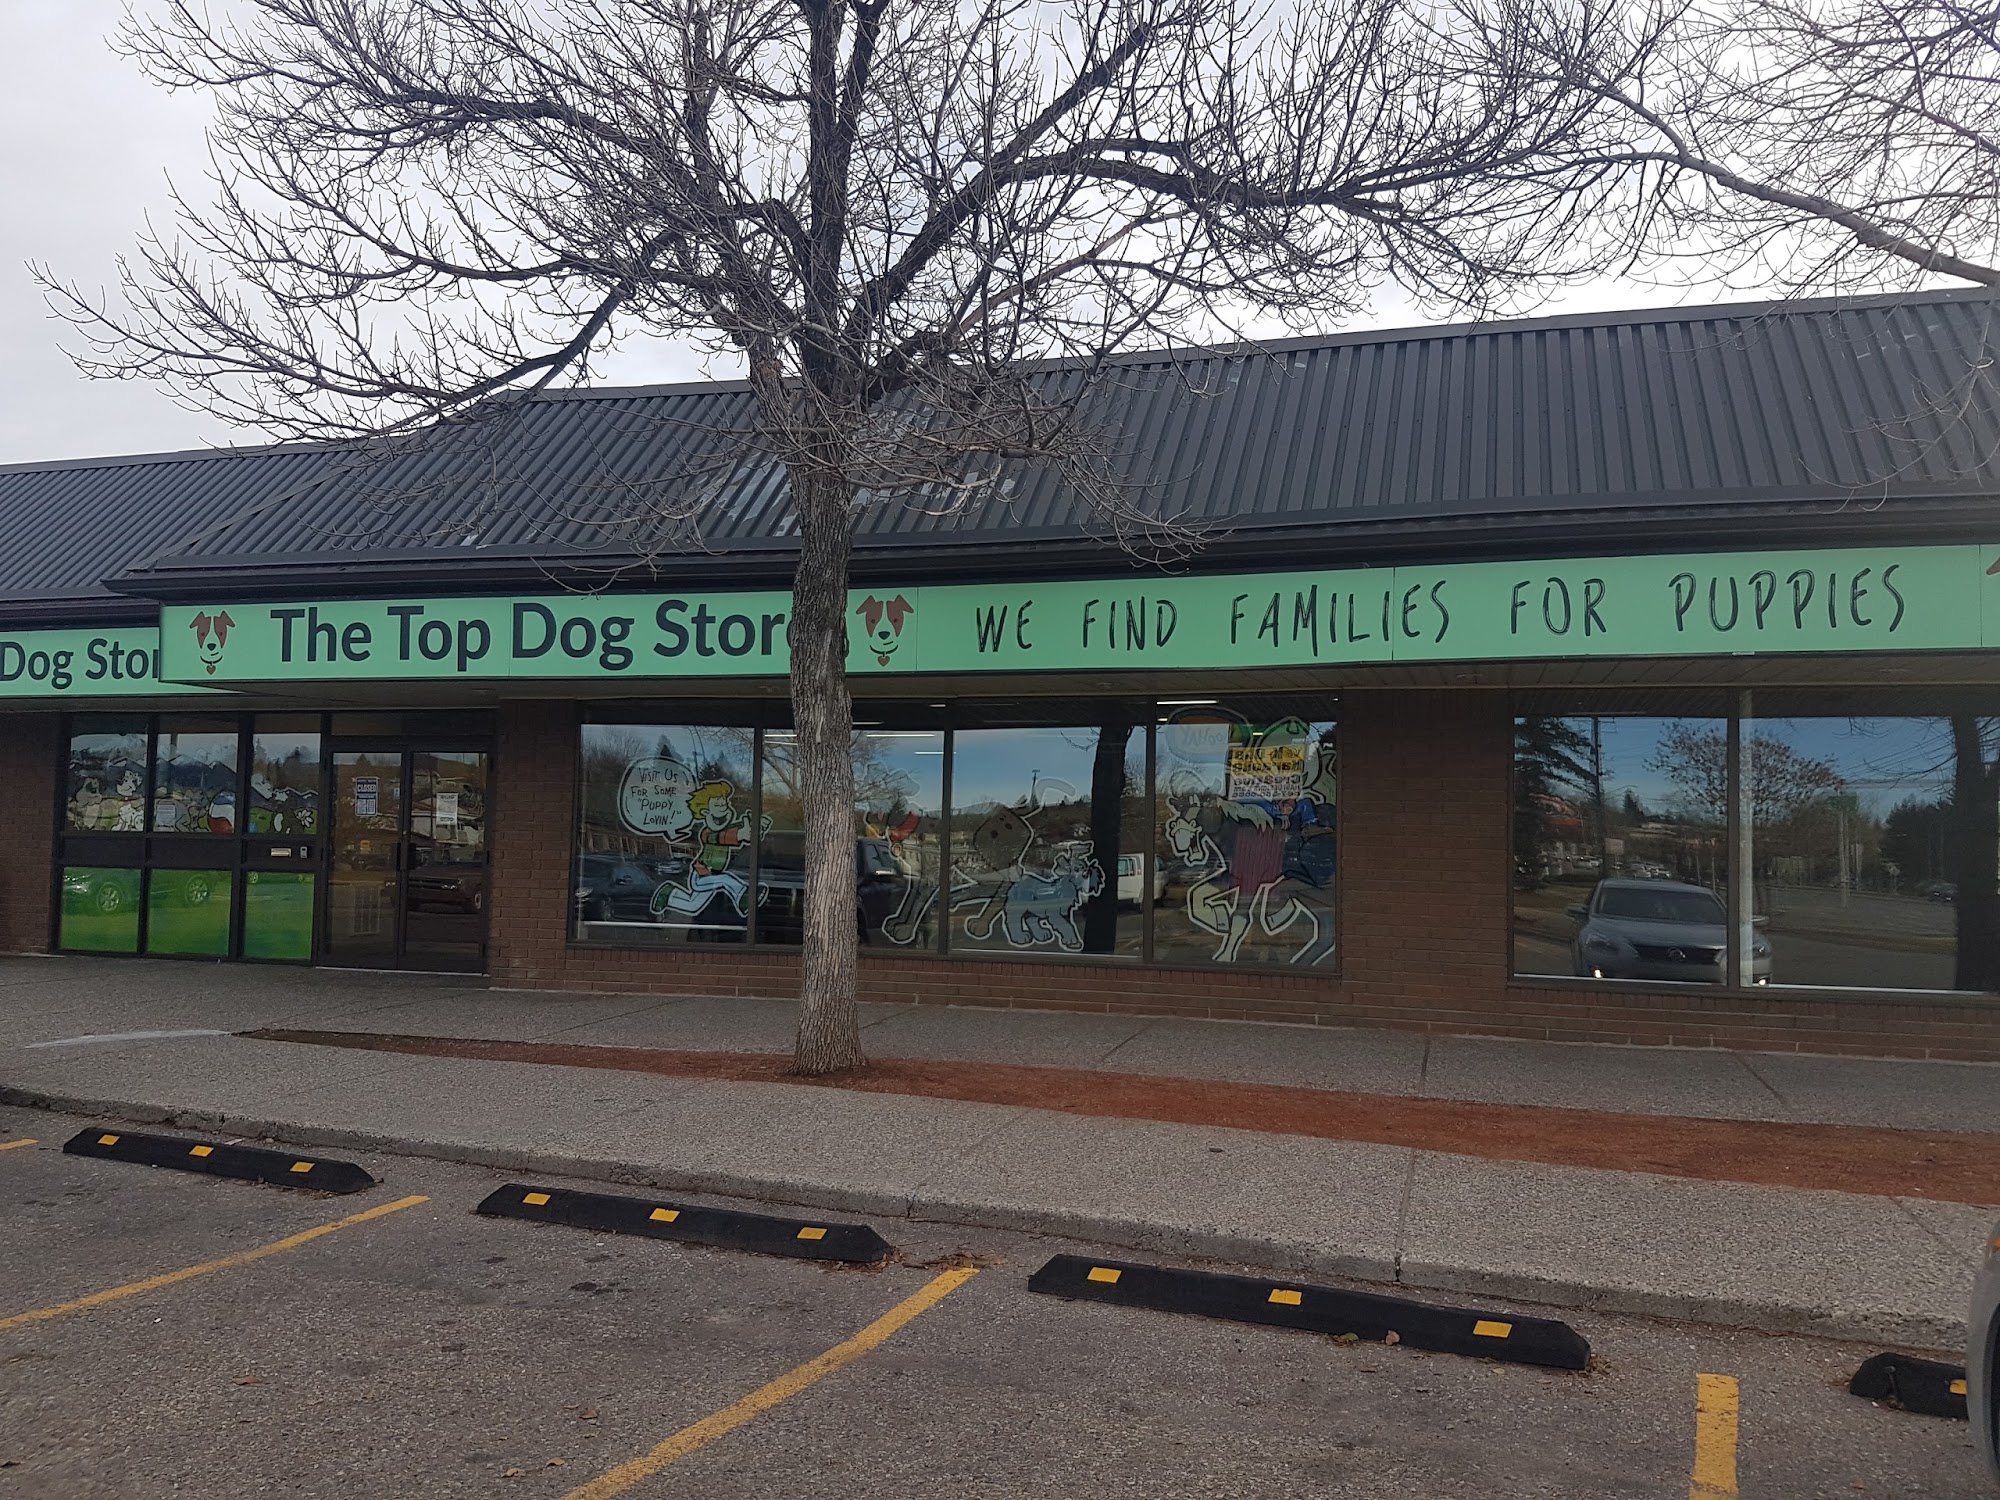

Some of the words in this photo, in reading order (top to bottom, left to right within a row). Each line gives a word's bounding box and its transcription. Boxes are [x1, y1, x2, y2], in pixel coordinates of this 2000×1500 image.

[269, 606, 373, 663] The
[387, 605, 492, 673] Top
[511, 602, 635, 672] Dog
[653, 599, 796, 660] Stor
[975, 599, 1034, 653] WE
[1082, 596, 1179, 652] FIND
[1231, 580, 1450, 658] FAMILIES
[1510, 576, 1607, 637] FOR
[1667, 563, 1906, 634] PUPPIES
[0, 640, 74, 690] Dog
[630, 786, 648, 797] FOR
[654, 785, 677, 798] SOME
